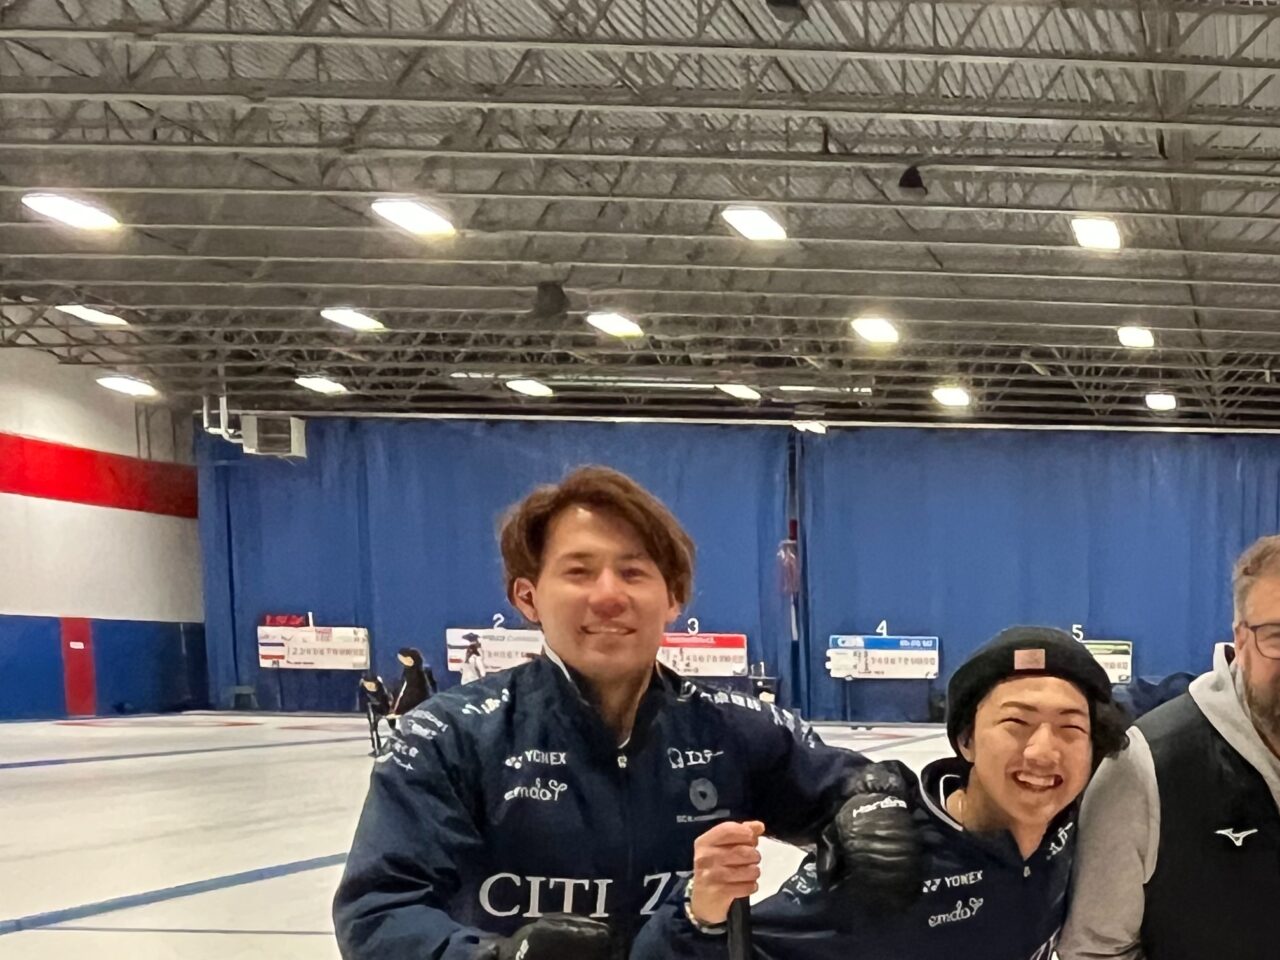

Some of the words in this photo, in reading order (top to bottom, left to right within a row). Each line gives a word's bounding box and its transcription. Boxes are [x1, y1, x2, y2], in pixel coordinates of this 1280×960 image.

[492, 612, 505, 629] 2
[687, 617, 699, 635] 3
[876, 619, 888, 636] 4
[1072, 623, 1084, 643] 5
[525, 750, 566, 766] YONEX
[945, 870, 983, 888] YONEX
[479, 872, 614, 917] CITI
[640, 870, 693, 916] Z
